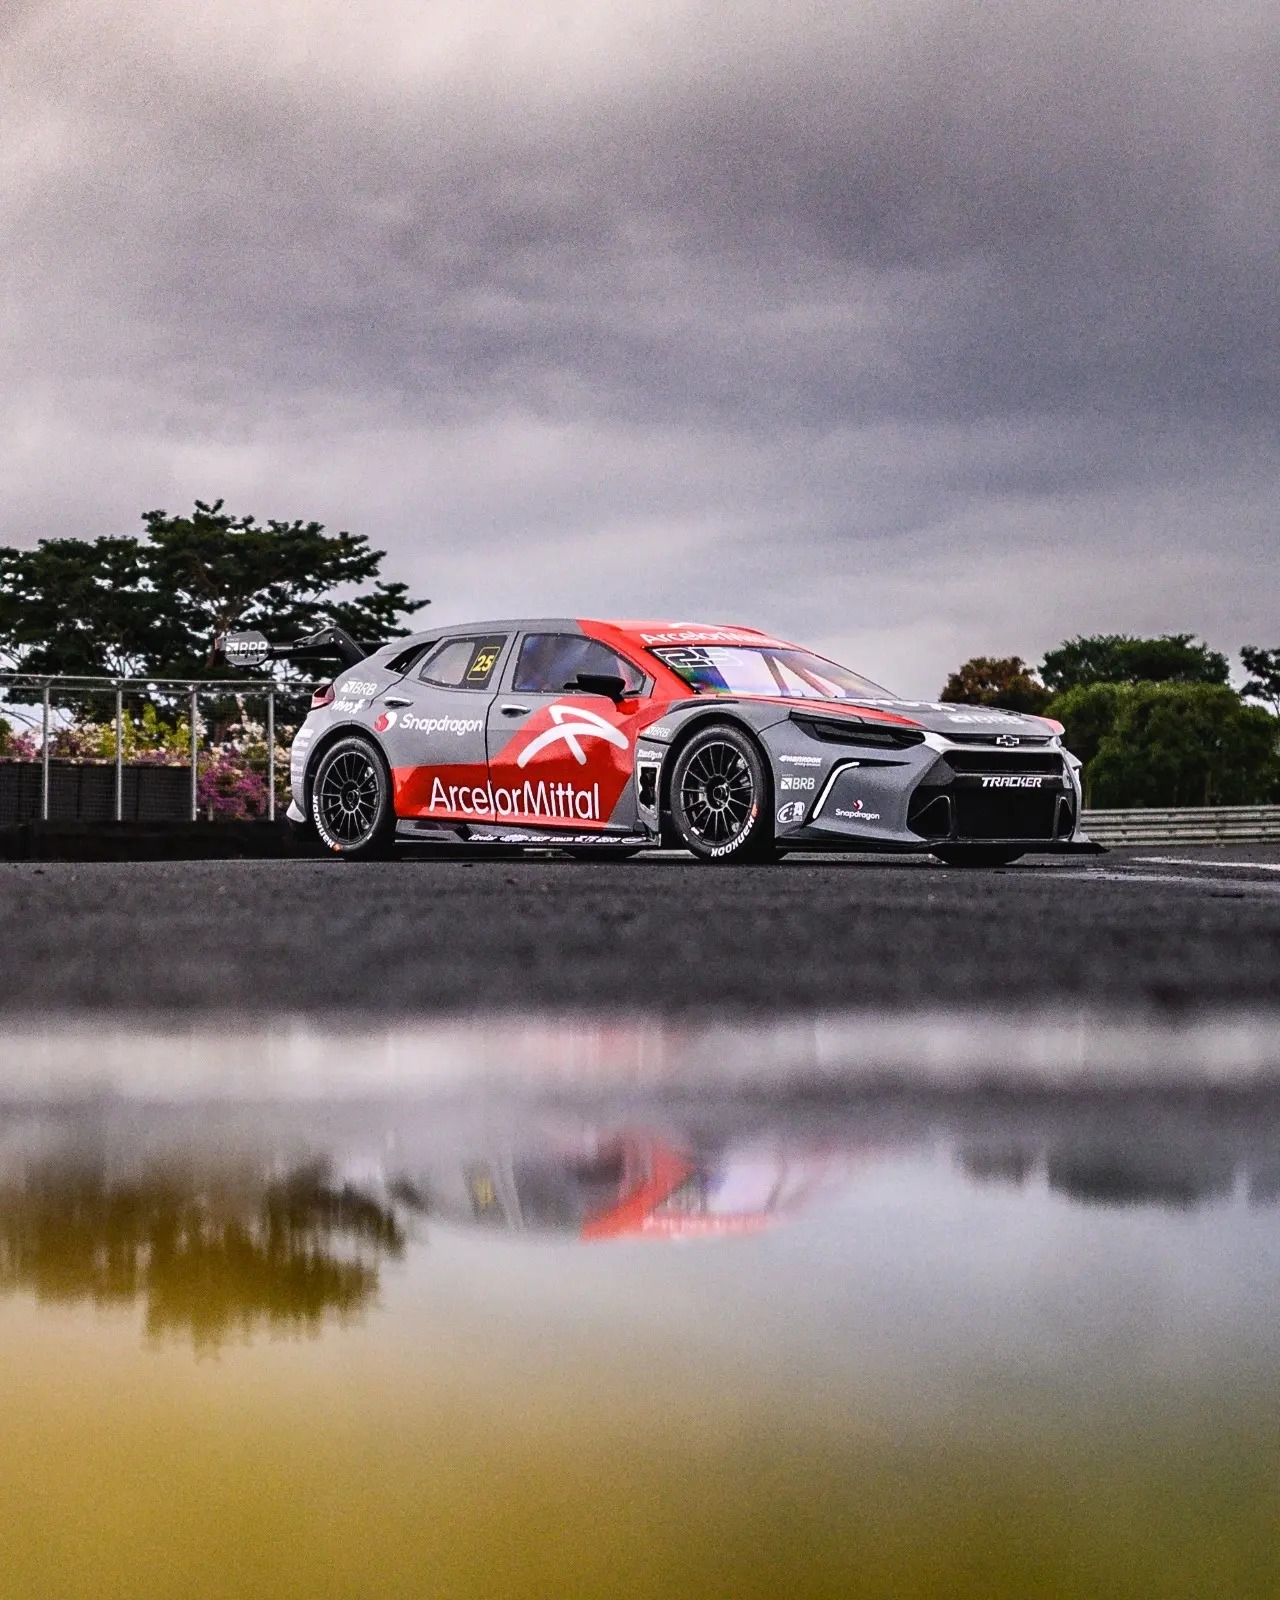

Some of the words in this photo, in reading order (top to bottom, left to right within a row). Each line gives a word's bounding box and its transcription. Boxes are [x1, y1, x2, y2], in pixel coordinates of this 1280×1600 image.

[472, 655, 495, 672] 25
[351, 681, 378, 696] BRB
[400, 713, 484, 736] Snapdragon
[651, 726, 671, 738] BRB
[792, 777, 815, 790] BRB
[981, 776, 1042, 788] TRACKER
[428, 776, 600, 820] ArcelorMittal
[835, 808, 880, 821] Snapdragon
